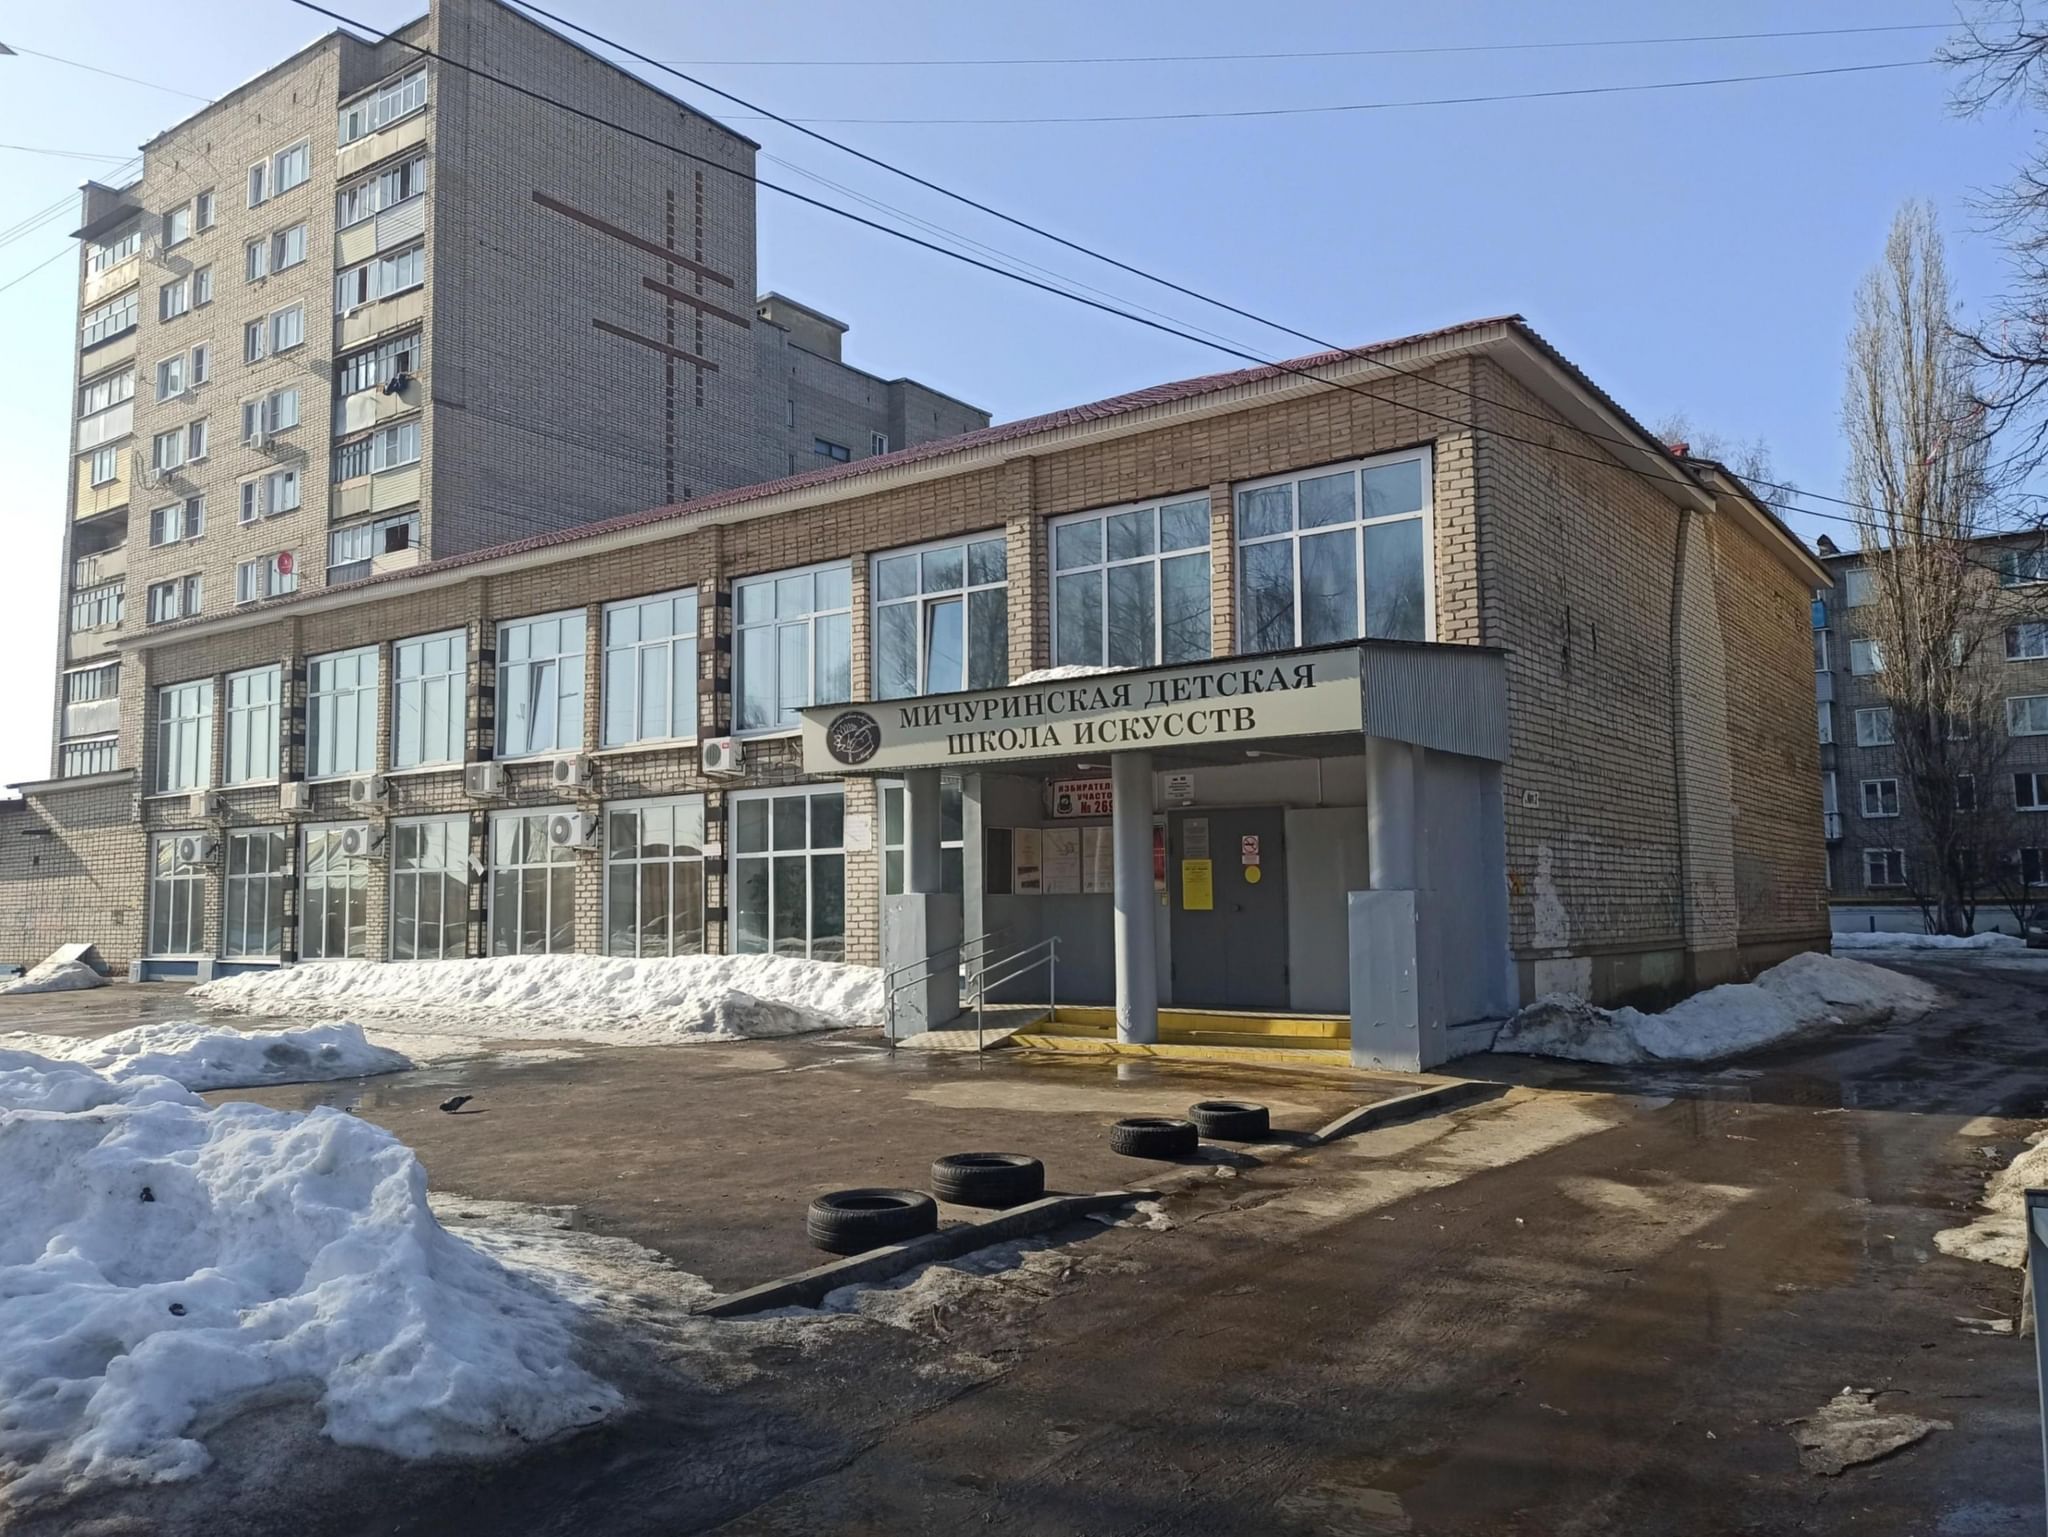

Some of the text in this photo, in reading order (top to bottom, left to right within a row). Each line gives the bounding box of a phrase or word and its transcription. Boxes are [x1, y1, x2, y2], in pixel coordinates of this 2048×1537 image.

[899, 663, 1317, 729] МИЧУРИНСКАЯ ДЕТСКАЯ
[947, 706, 1257, 756] ШКОЛА ИСКУССТВ
[1058, 782, 1112, 793] ИЗБИРАТЕЛ
[1077, 791, 1112, 801] УЧАСТО
